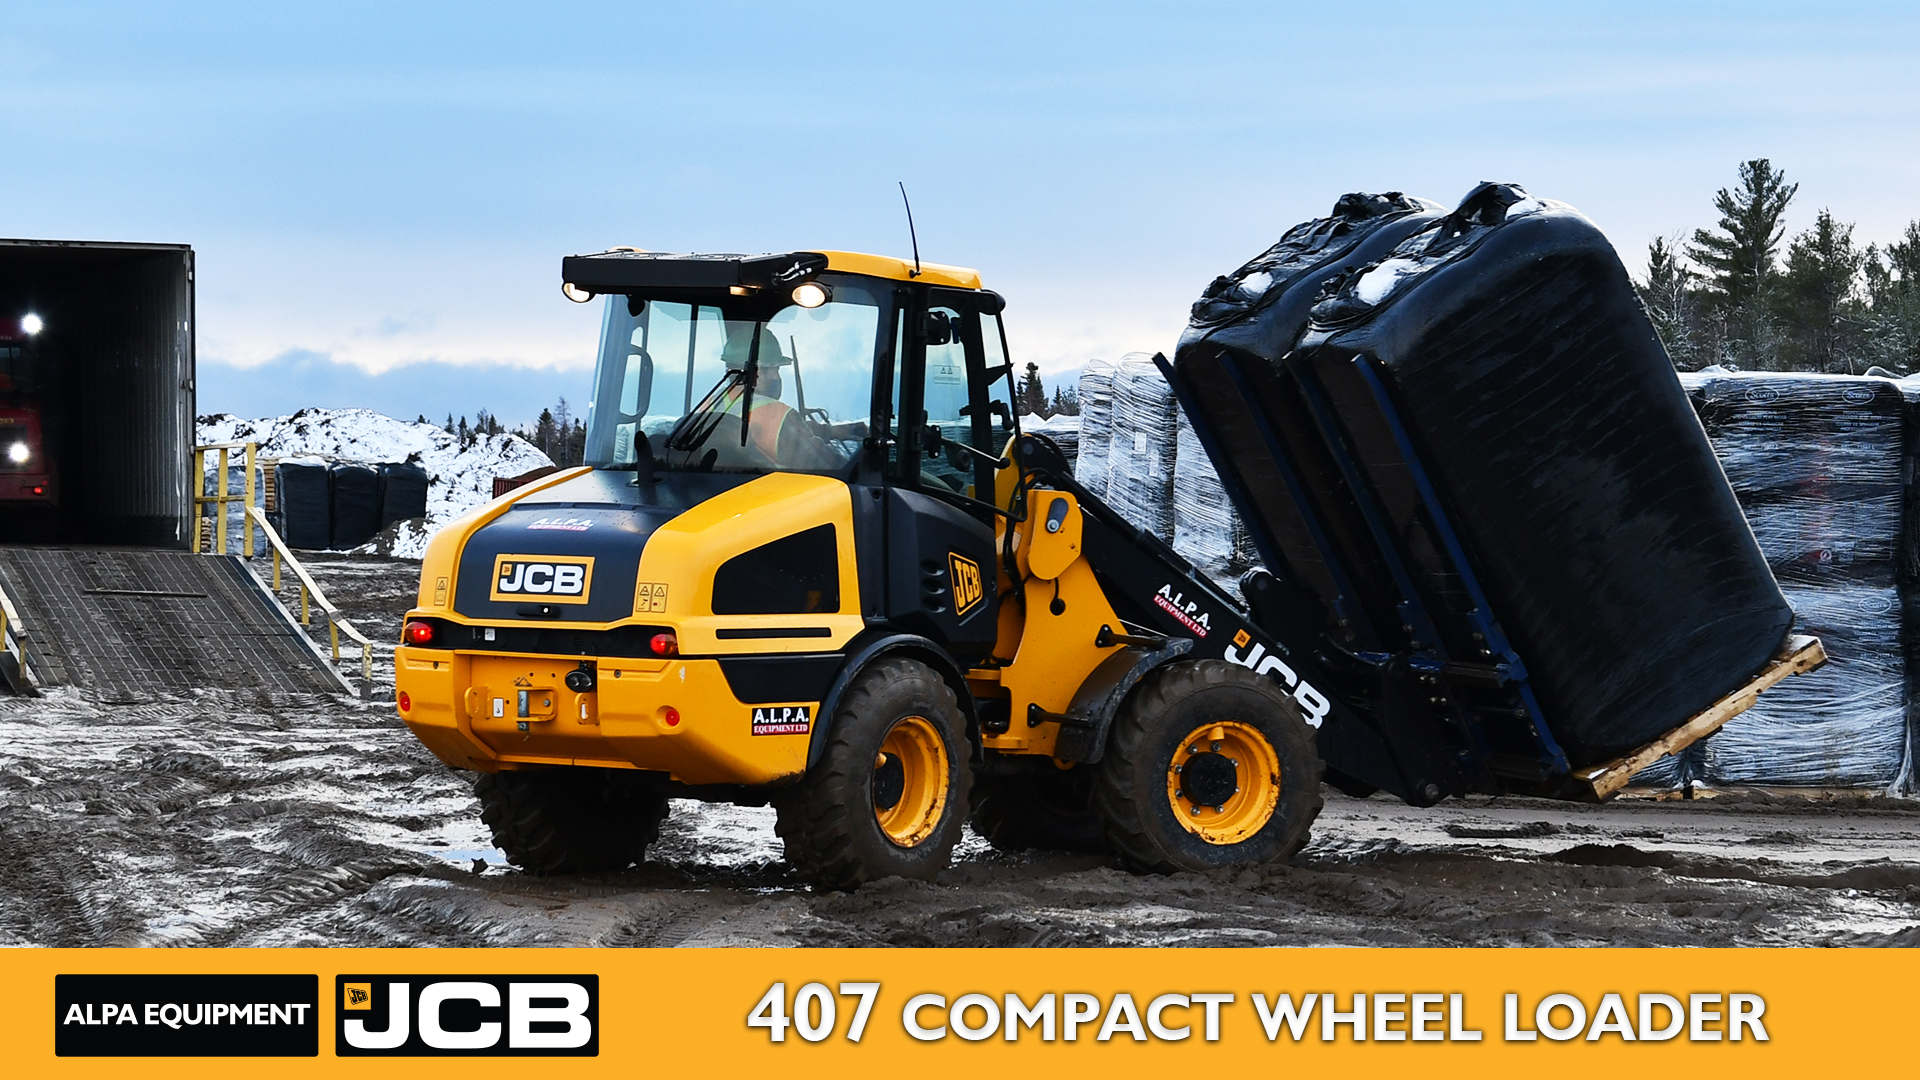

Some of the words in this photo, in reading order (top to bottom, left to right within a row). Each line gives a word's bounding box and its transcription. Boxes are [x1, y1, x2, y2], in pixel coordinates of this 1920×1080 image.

[532, 518, 594, 527] A.L.P.A.
[500, 563, 584, 594] JCB
[954, 559, 980, 608] JCB
[1154, 594, 1194, 627] EQUIPMENT
[1192, 623, 1207, 637] LTD
[1157, 583, 1212, 631] A.L.P.A.
[753, 707, 809, 724] A.L.P.A.
[753, 724, 795, 734] EQUIPMENT
[795, 724, 808, 732] LTD
